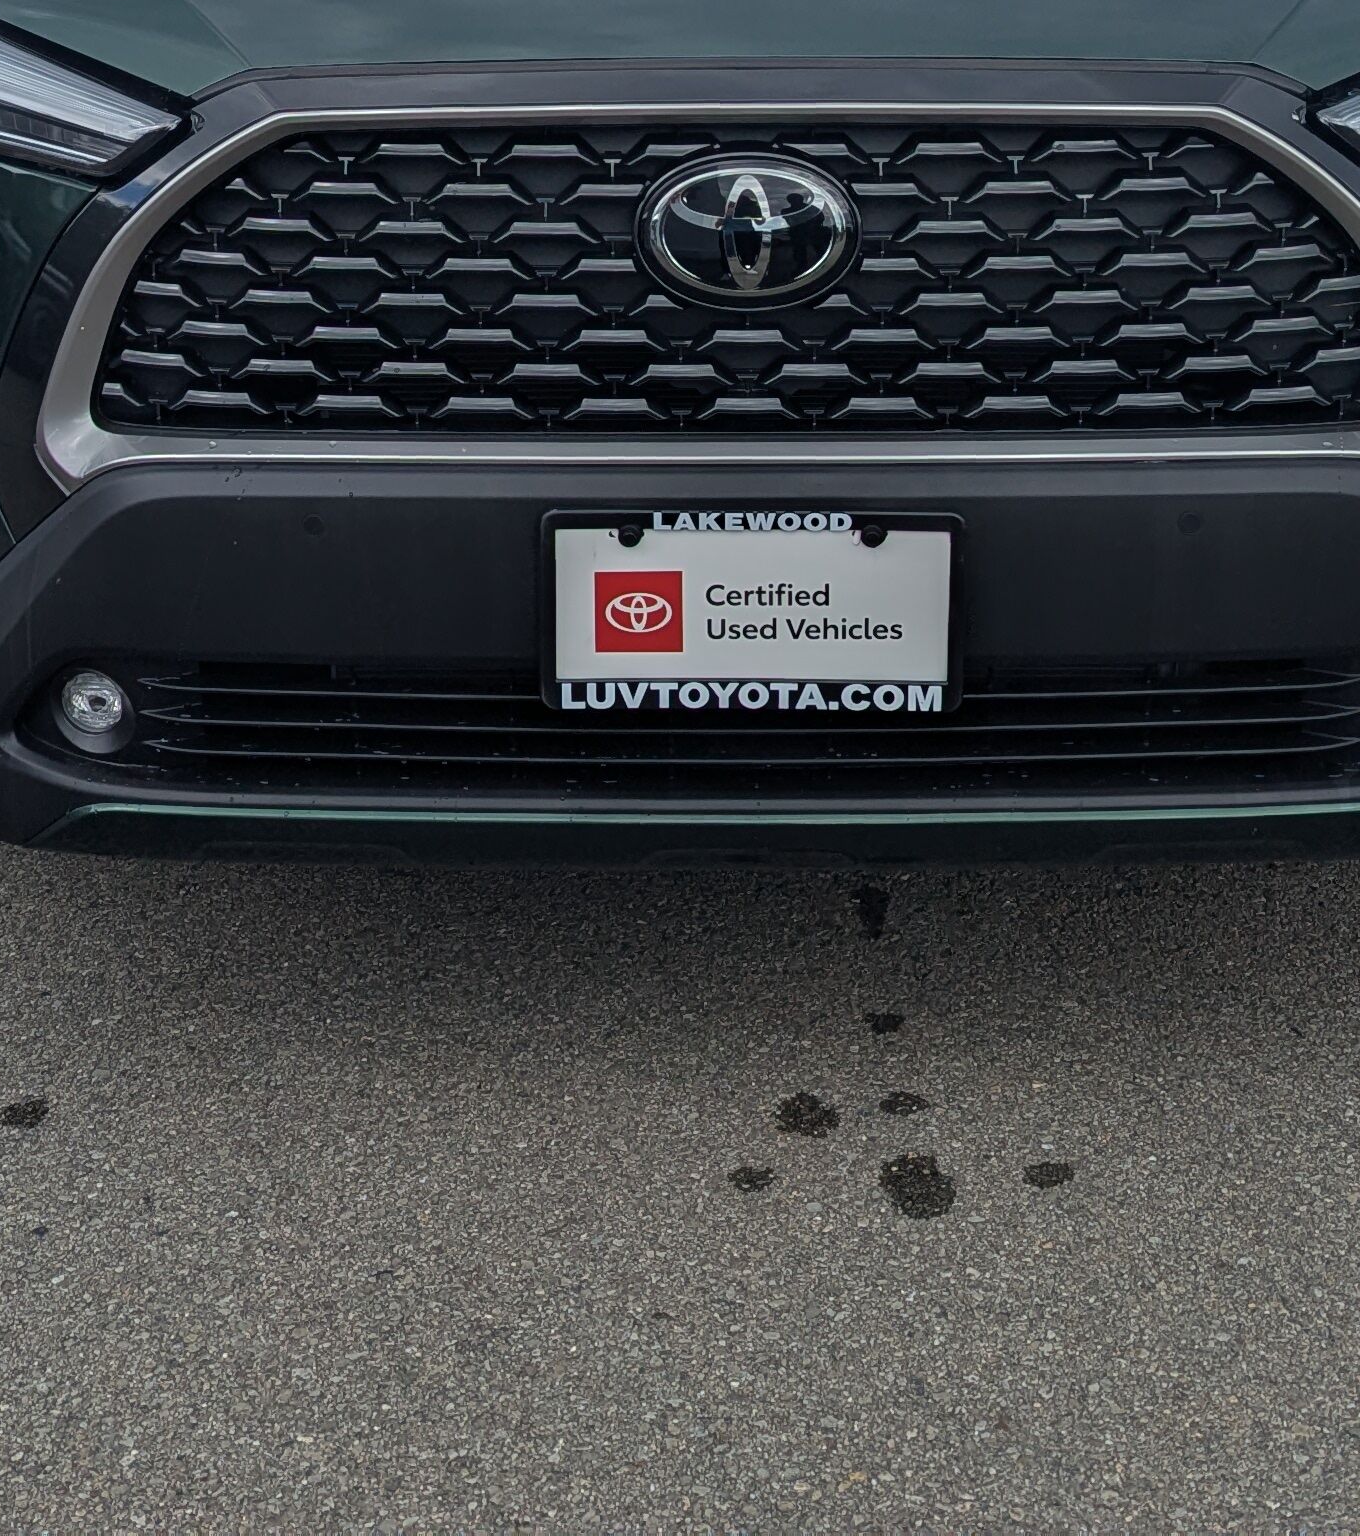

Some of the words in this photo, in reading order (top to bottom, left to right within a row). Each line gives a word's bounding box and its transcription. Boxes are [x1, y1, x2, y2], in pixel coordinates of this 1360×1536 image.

[652, 511, 853, 532] LAKEWOOD
[705, 583, 830, 607] Certified
[706, 618, 777, 640] Used
[786, 618, 903, 640] Vehicles
[561, 681, 942, 712] LUVTOYOTA.COM
